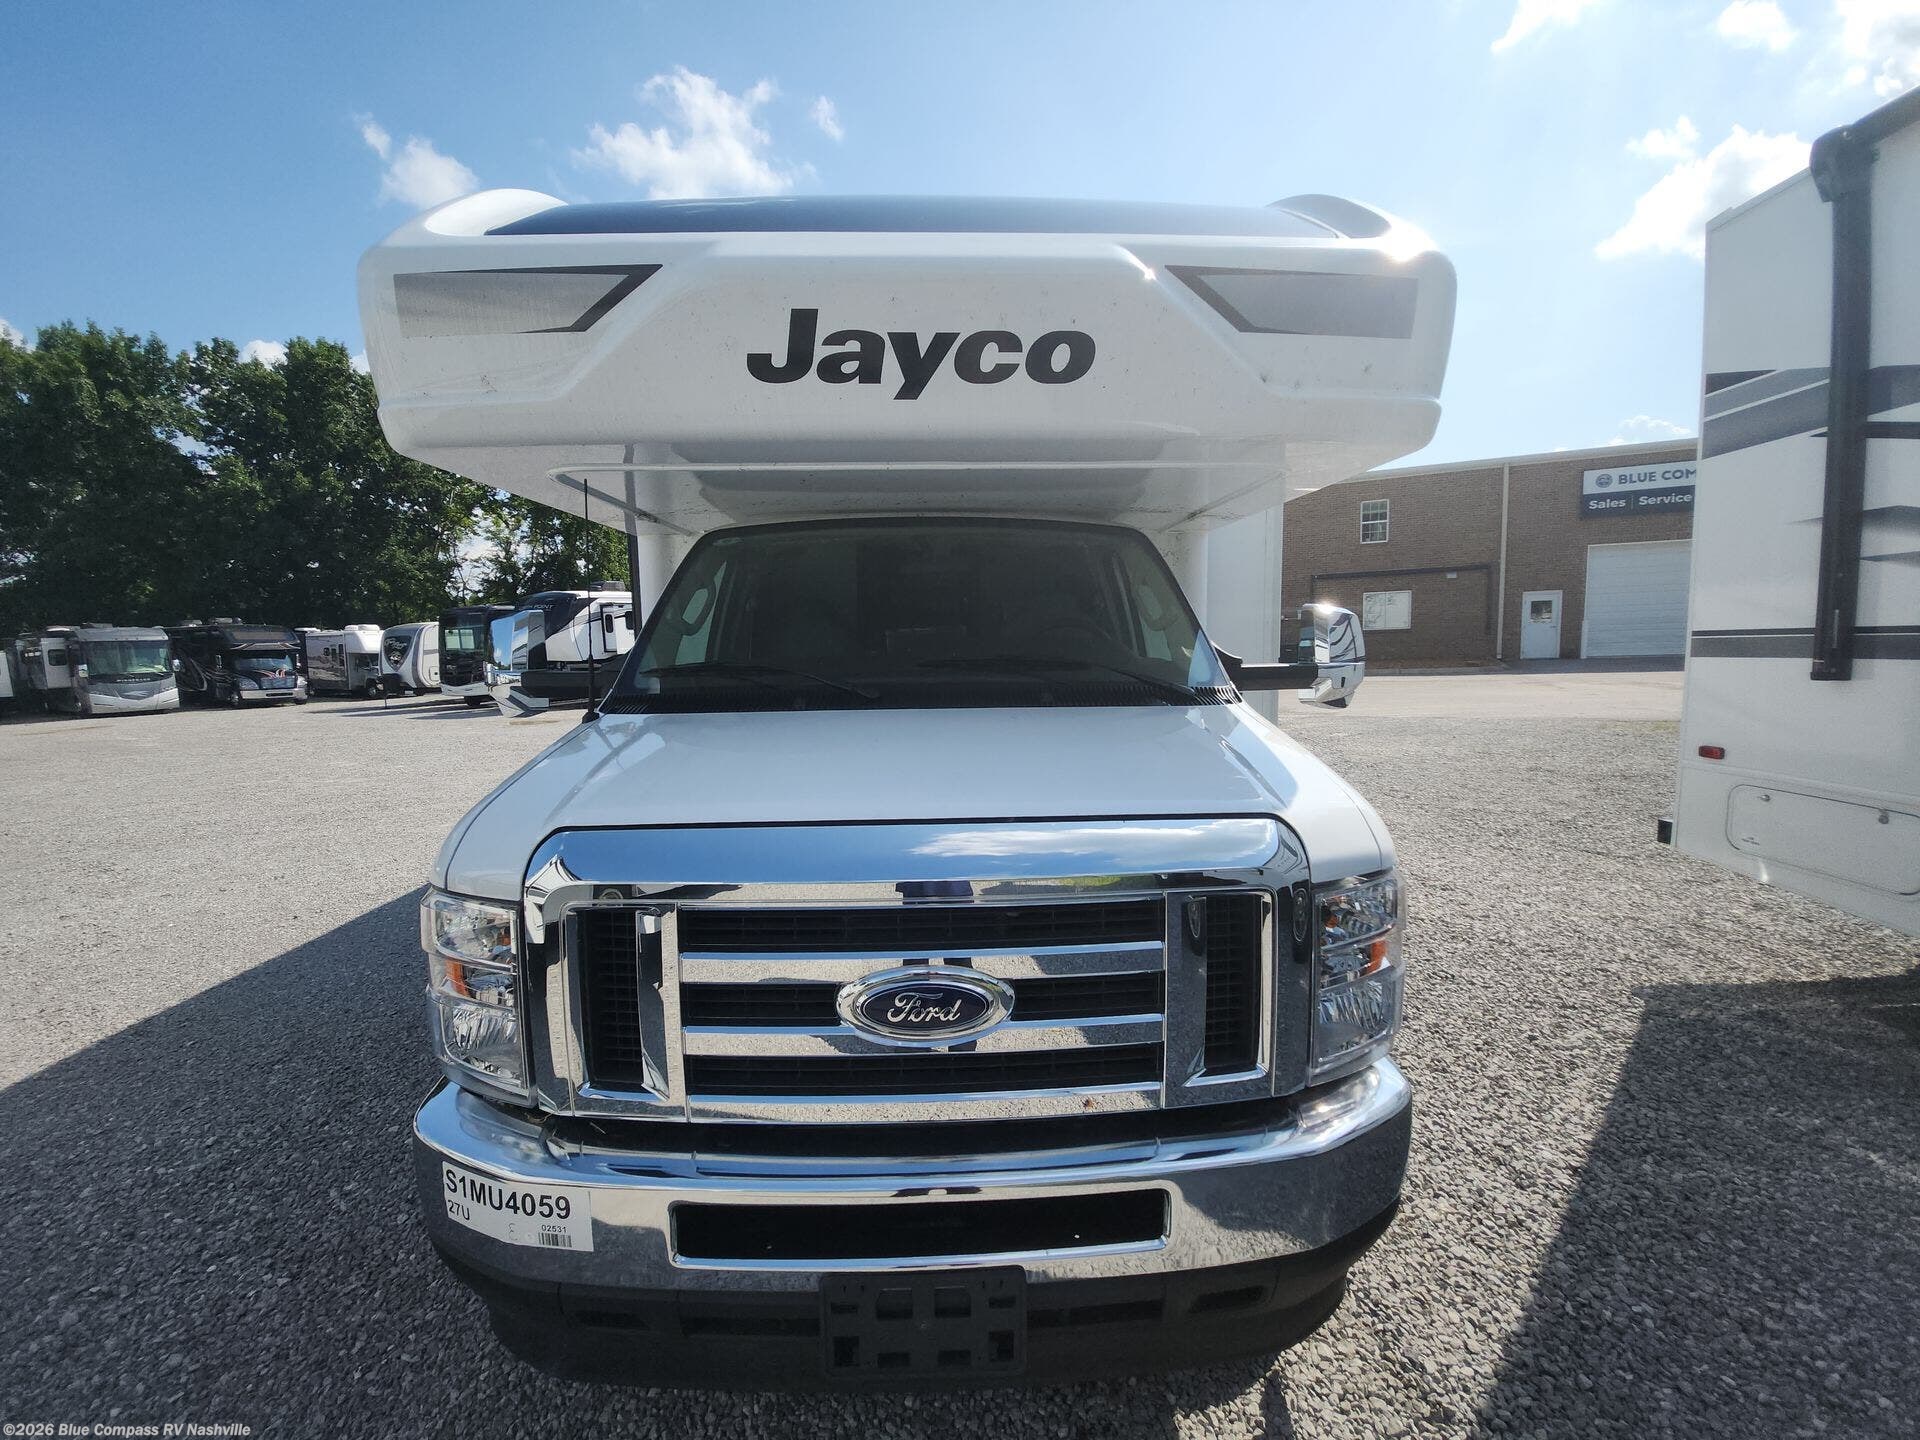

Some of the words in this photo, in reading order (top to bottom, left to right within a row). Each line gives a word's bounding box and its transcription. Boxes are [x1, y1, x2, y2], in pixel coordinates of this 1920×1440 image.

[746, 308, 1096, 400] Jayco
[1618, 471, 1657, 485] BLUE
[1588, 498, 1627, 510] Sales
[1638, 492, 1693, 506] Service
[886, 992, 963, 1023] Ford
[445, 1169, 571, 1220] S1MU4059
[447, 1199, 471, 1221] 27U
[540, 1224, 567, 1234] 02531
